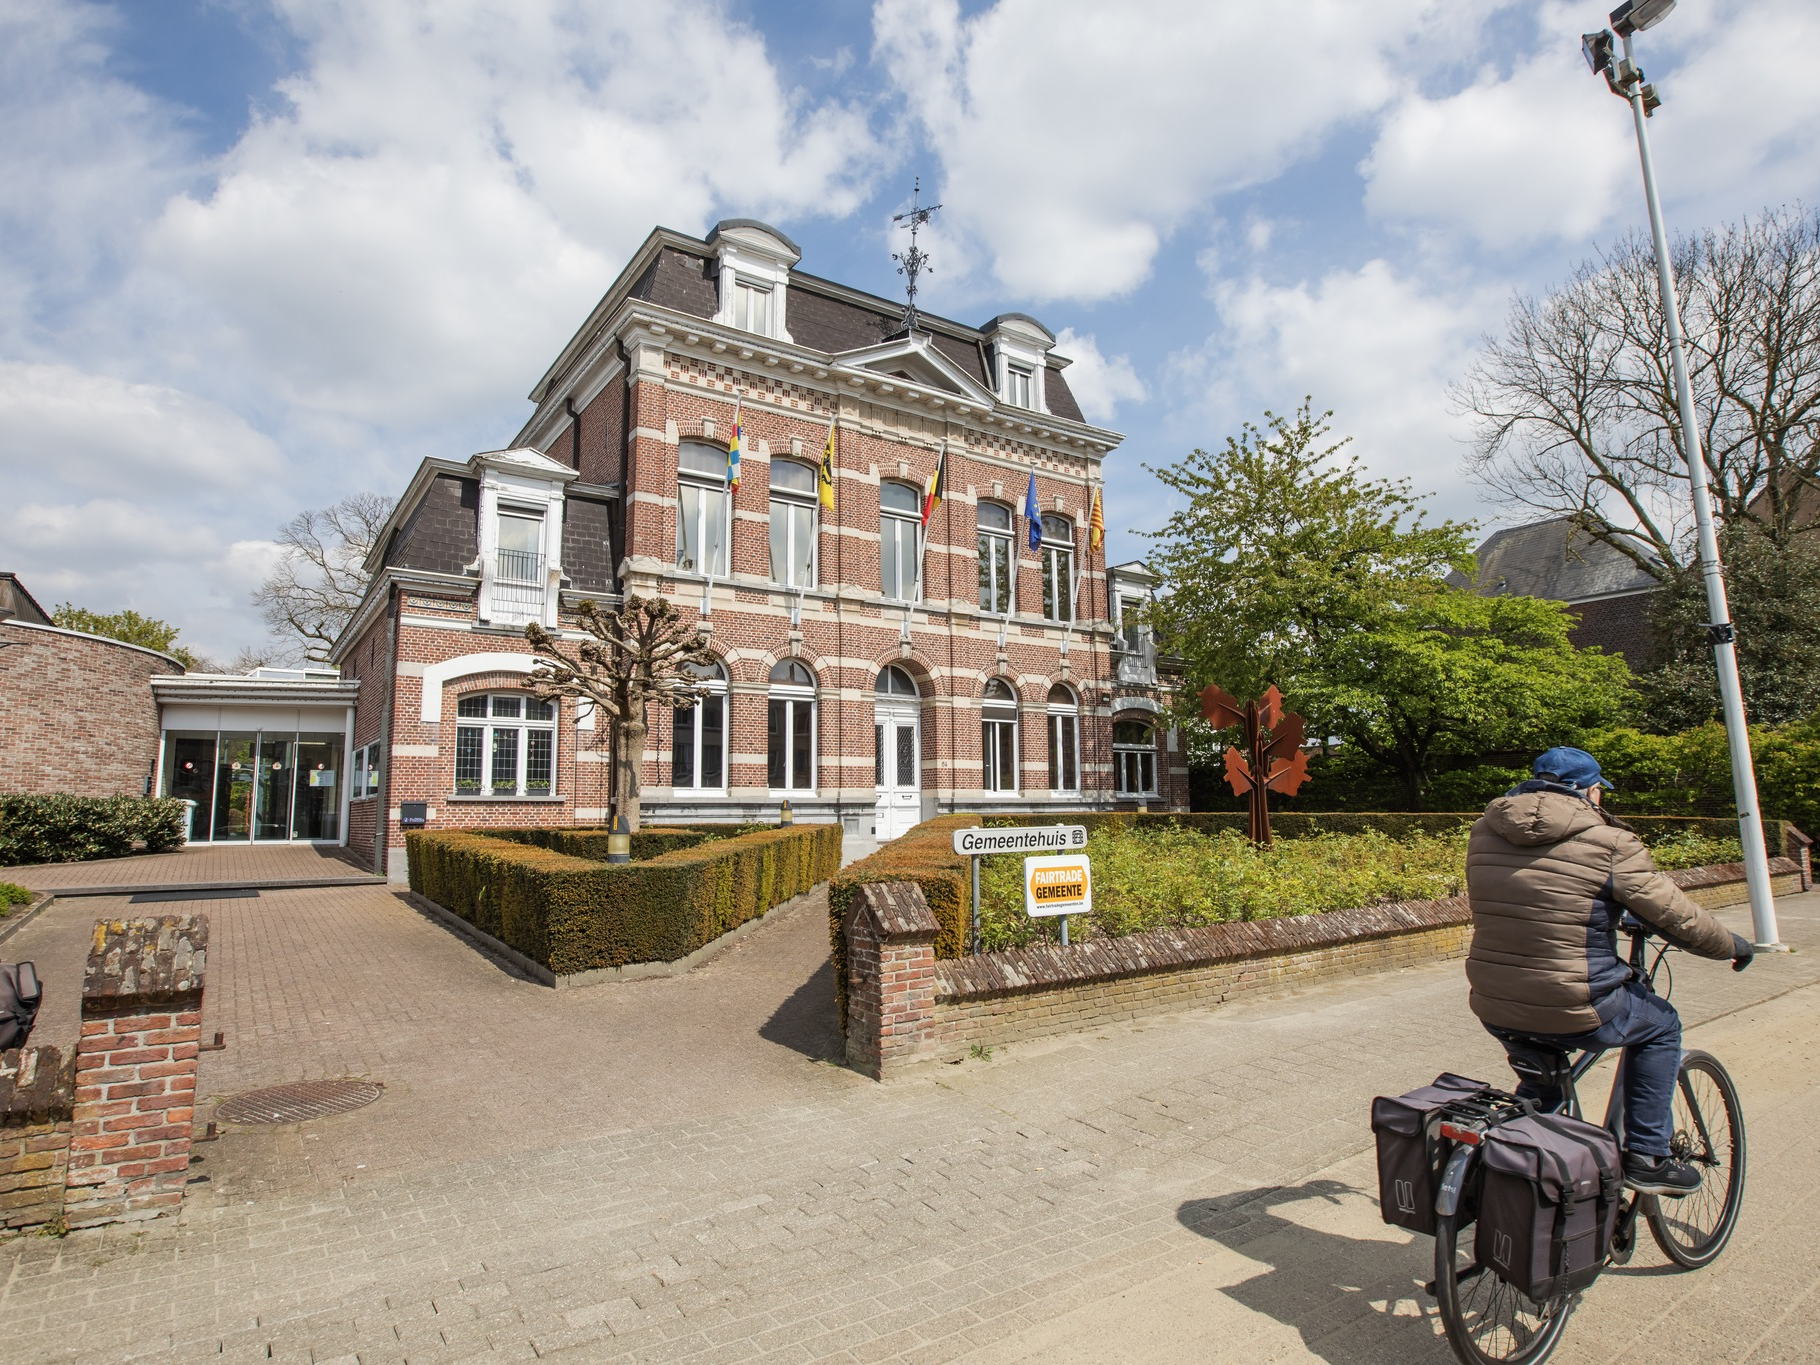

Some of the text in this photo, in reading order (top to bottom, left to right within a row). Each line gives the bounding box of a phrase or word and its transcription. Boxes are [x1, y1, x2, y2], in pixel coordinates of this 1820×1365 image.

[962, 831, 1067, 850] Gemeentehuis
[1035, 869, 1083, 884] FAIRTRADE
[1036, 884, 1082, 899] GEMEENTE
